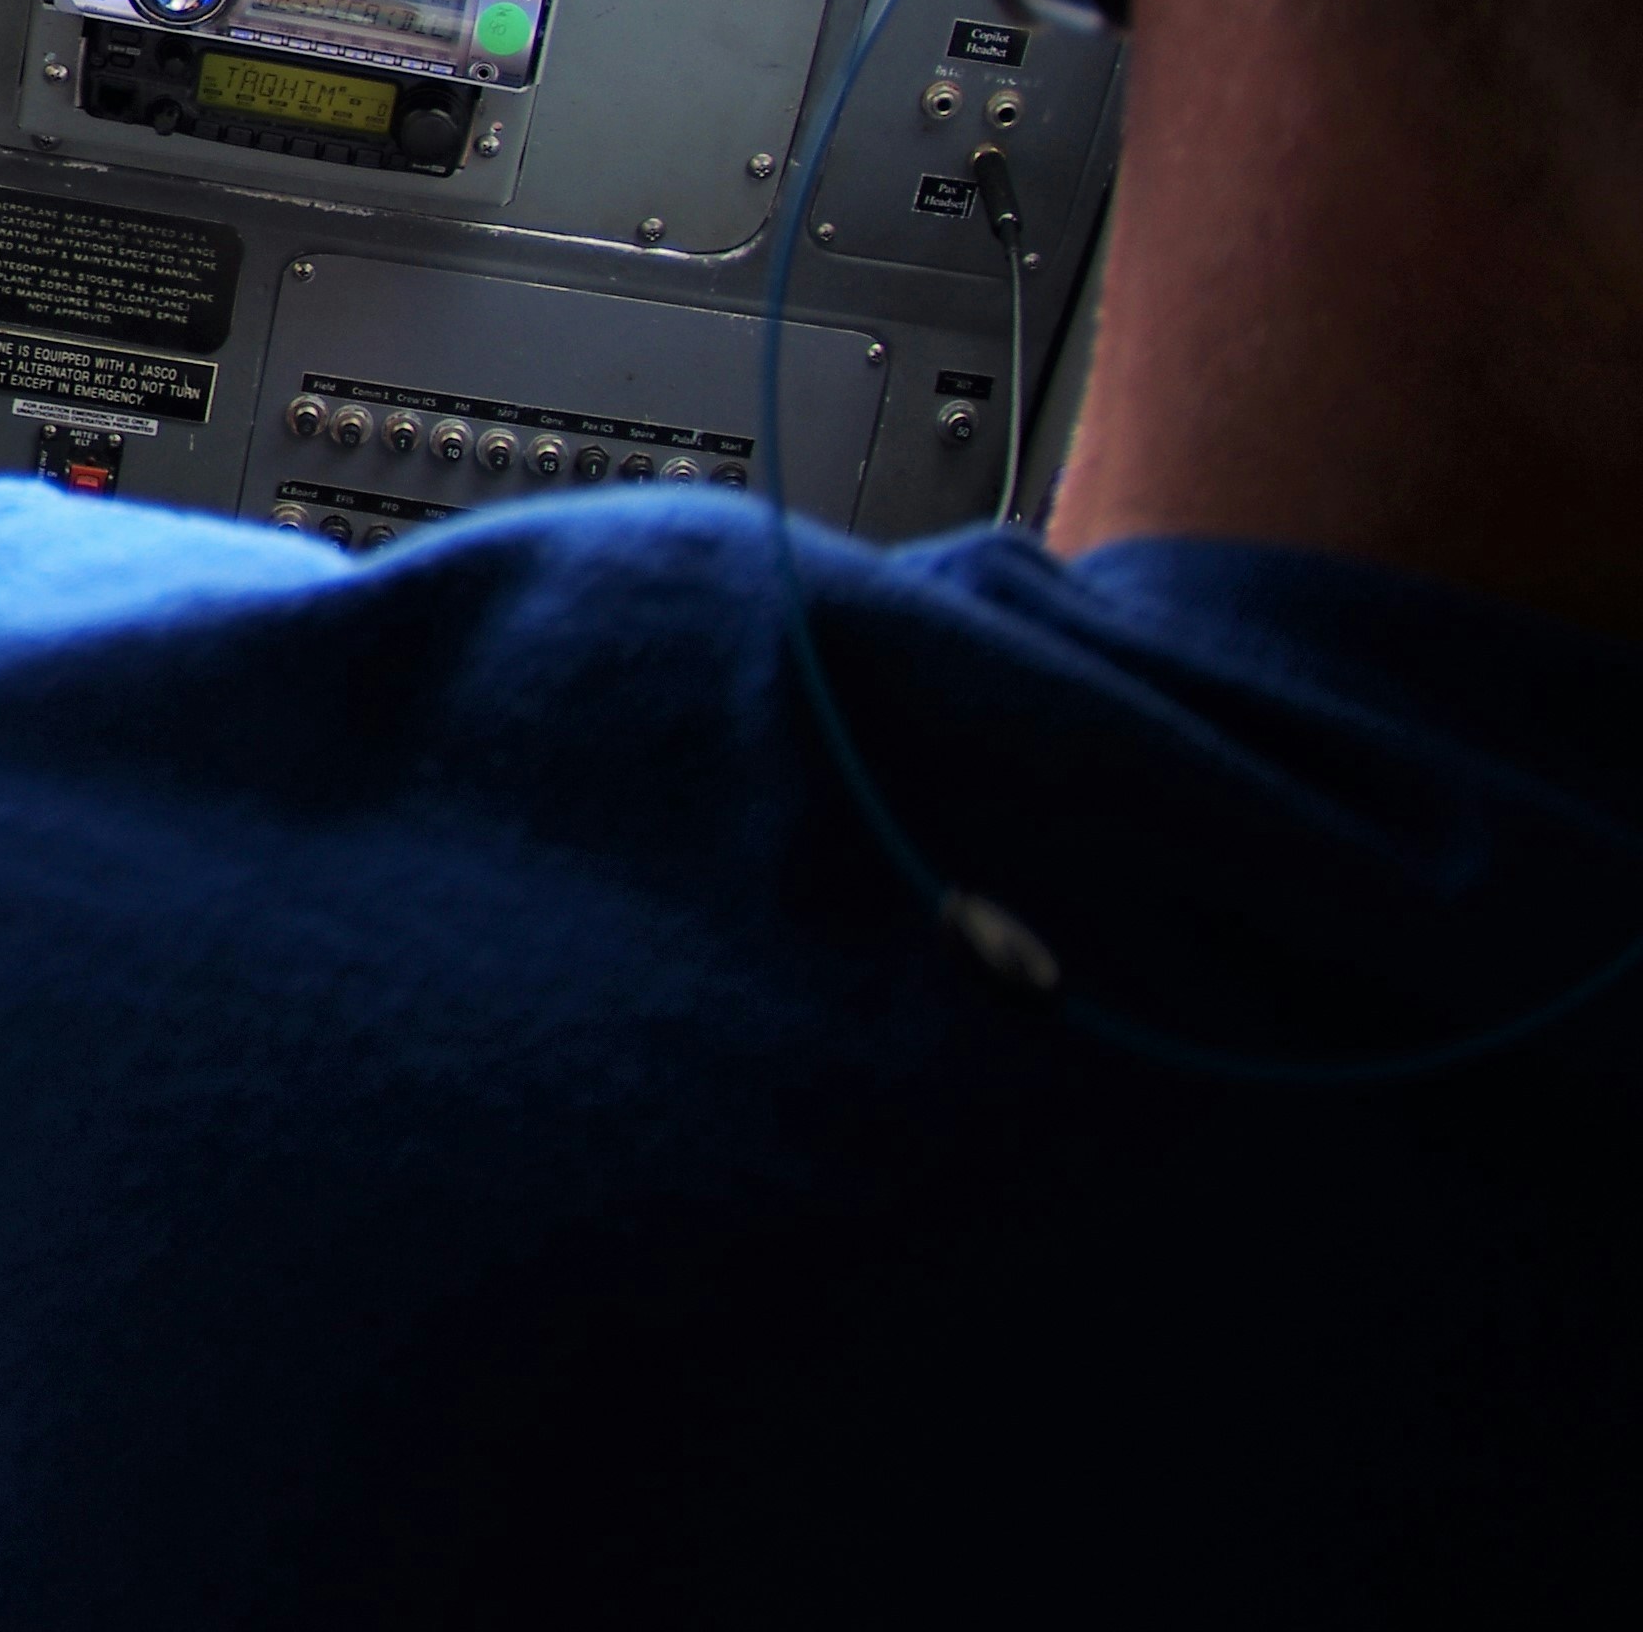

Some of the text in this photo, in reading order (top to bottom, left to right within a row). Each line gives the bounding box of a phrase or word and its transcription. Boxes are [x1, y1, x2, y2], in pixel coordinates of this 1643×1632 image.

[971, 29, 1009, 43] Copilot
[966, 43, 1007, 58] Headset
[939, 184, 957, 194] Pax
[925, 195, 965, 209] Headset
[19, 345, 29, 356] IS
[35, 347, 91, 366] EQUIPPED
[95, 356, 125, 372] WITH
[127, 362, 135, 373] A
[140, 363, 176, 380] JASCO
[16, 360, 91, 382] ALTERNATOR
[121, 377, 137, 390] DO
[141, 380, 165, 394] NOT
[170, 384, 201, 399] TURN
[11, 374, 53, 390] EXCEPT
[58, 382, 70, 393] IN
[75, 384, 145, 406] EMERGENCY.
[353, 386, 382, 398] Comm
[39, 404, 115, 420] AVIATION EMERGENCY
[69, 430, 99, 440] ARTEX
[75, 438, 92, 446] ELT
[281, 485, 317, 498] K.Board
